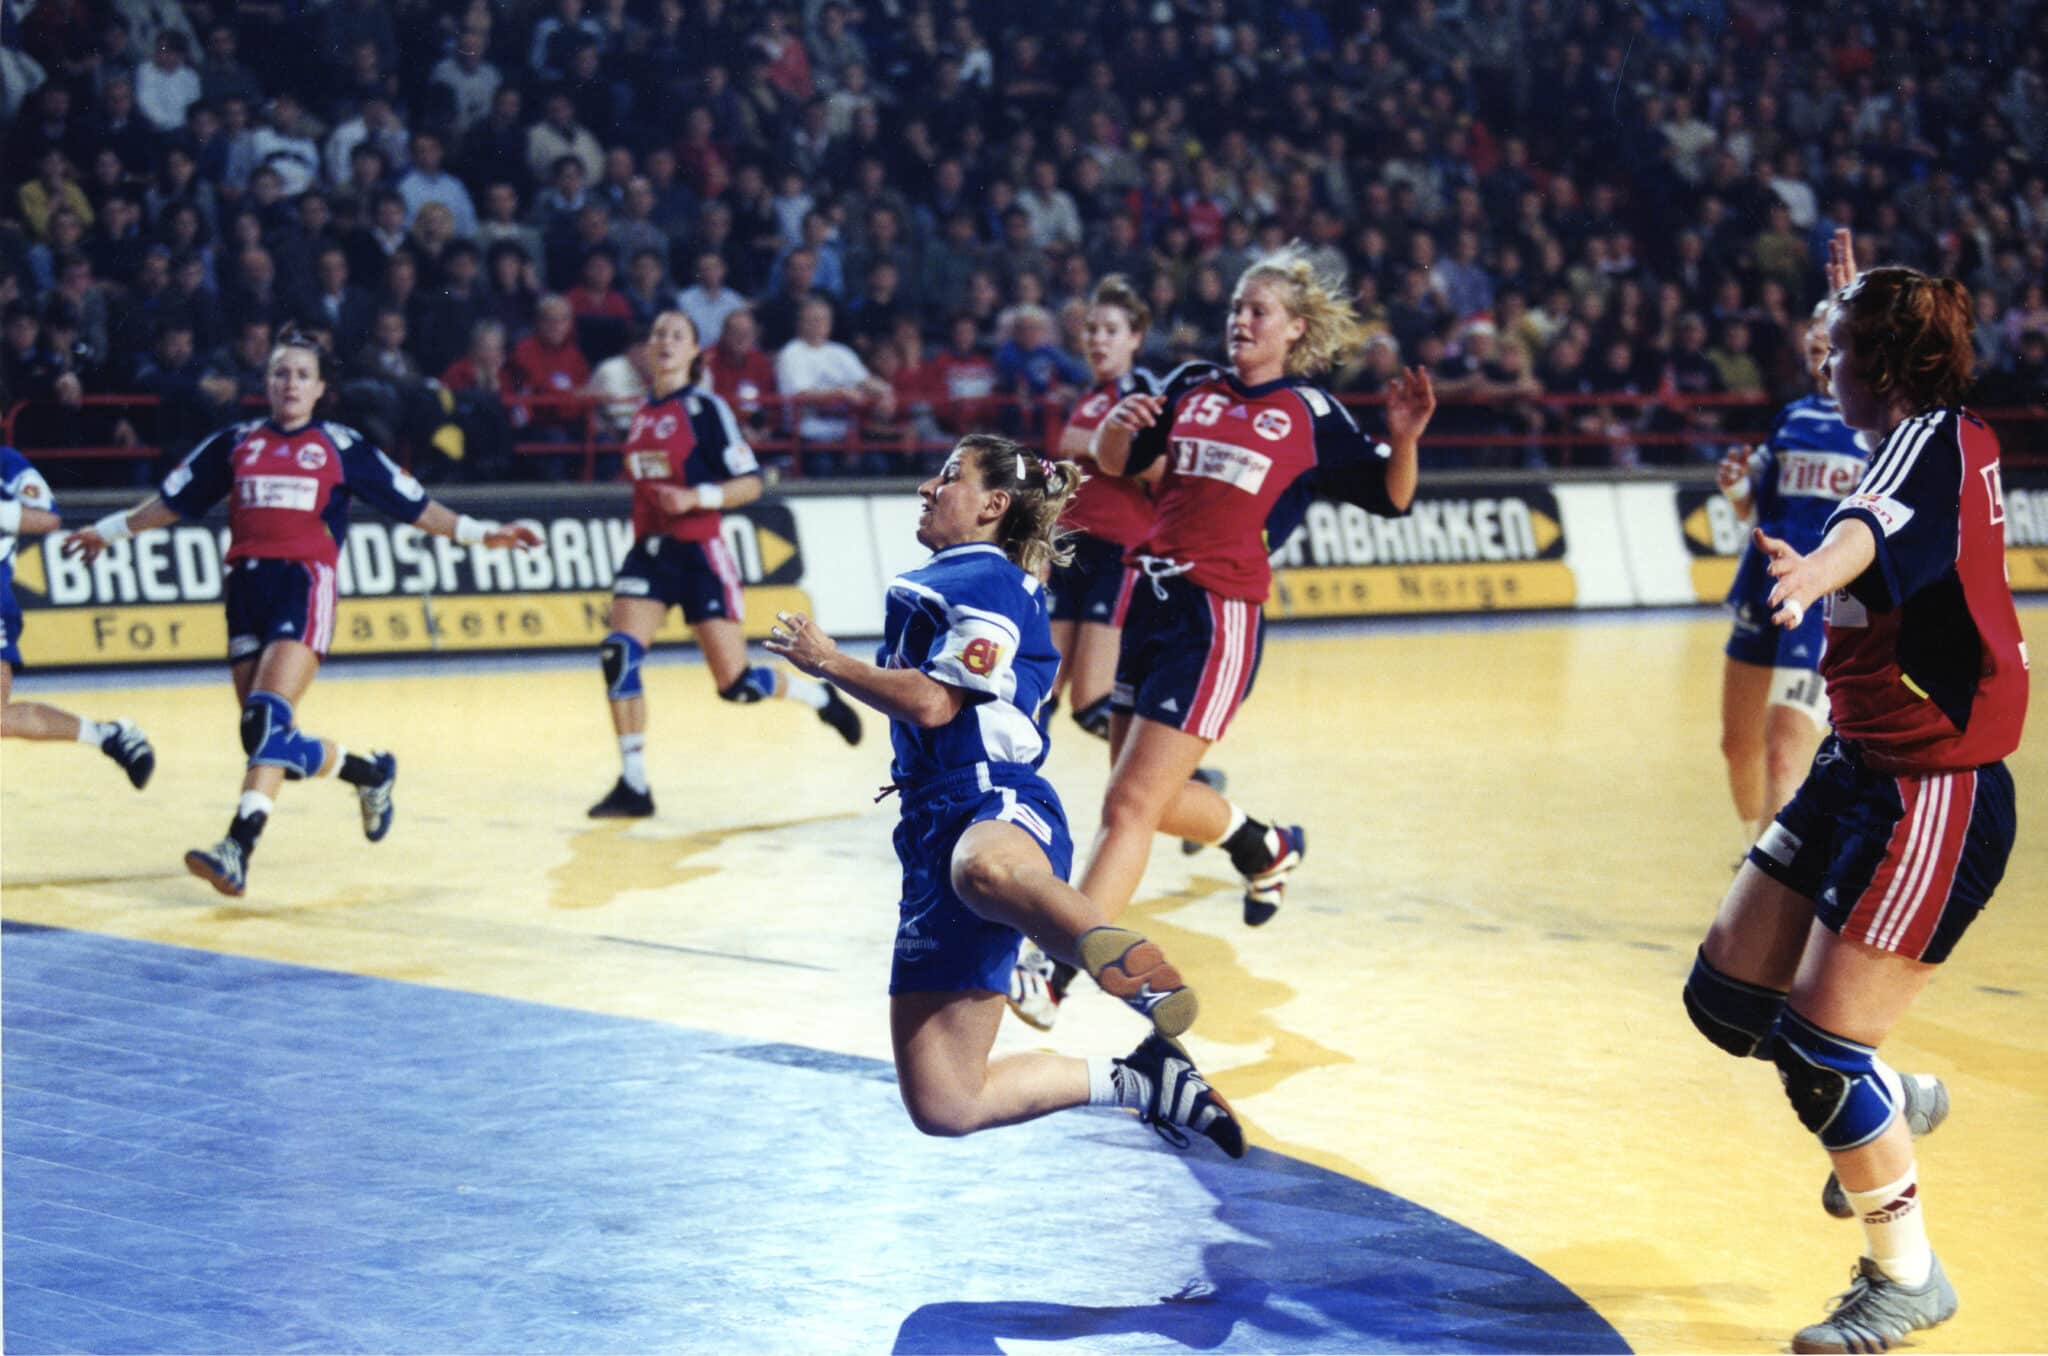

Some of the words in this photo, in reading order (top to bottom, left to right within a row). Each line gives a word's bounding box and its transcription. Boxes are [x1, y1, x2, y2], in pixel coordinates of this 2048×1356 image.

[1178, 393, 1231, 427] 15
[1268, 498, 1537, 566] FABRIKKEN
[93, 613, 182, 652] For
